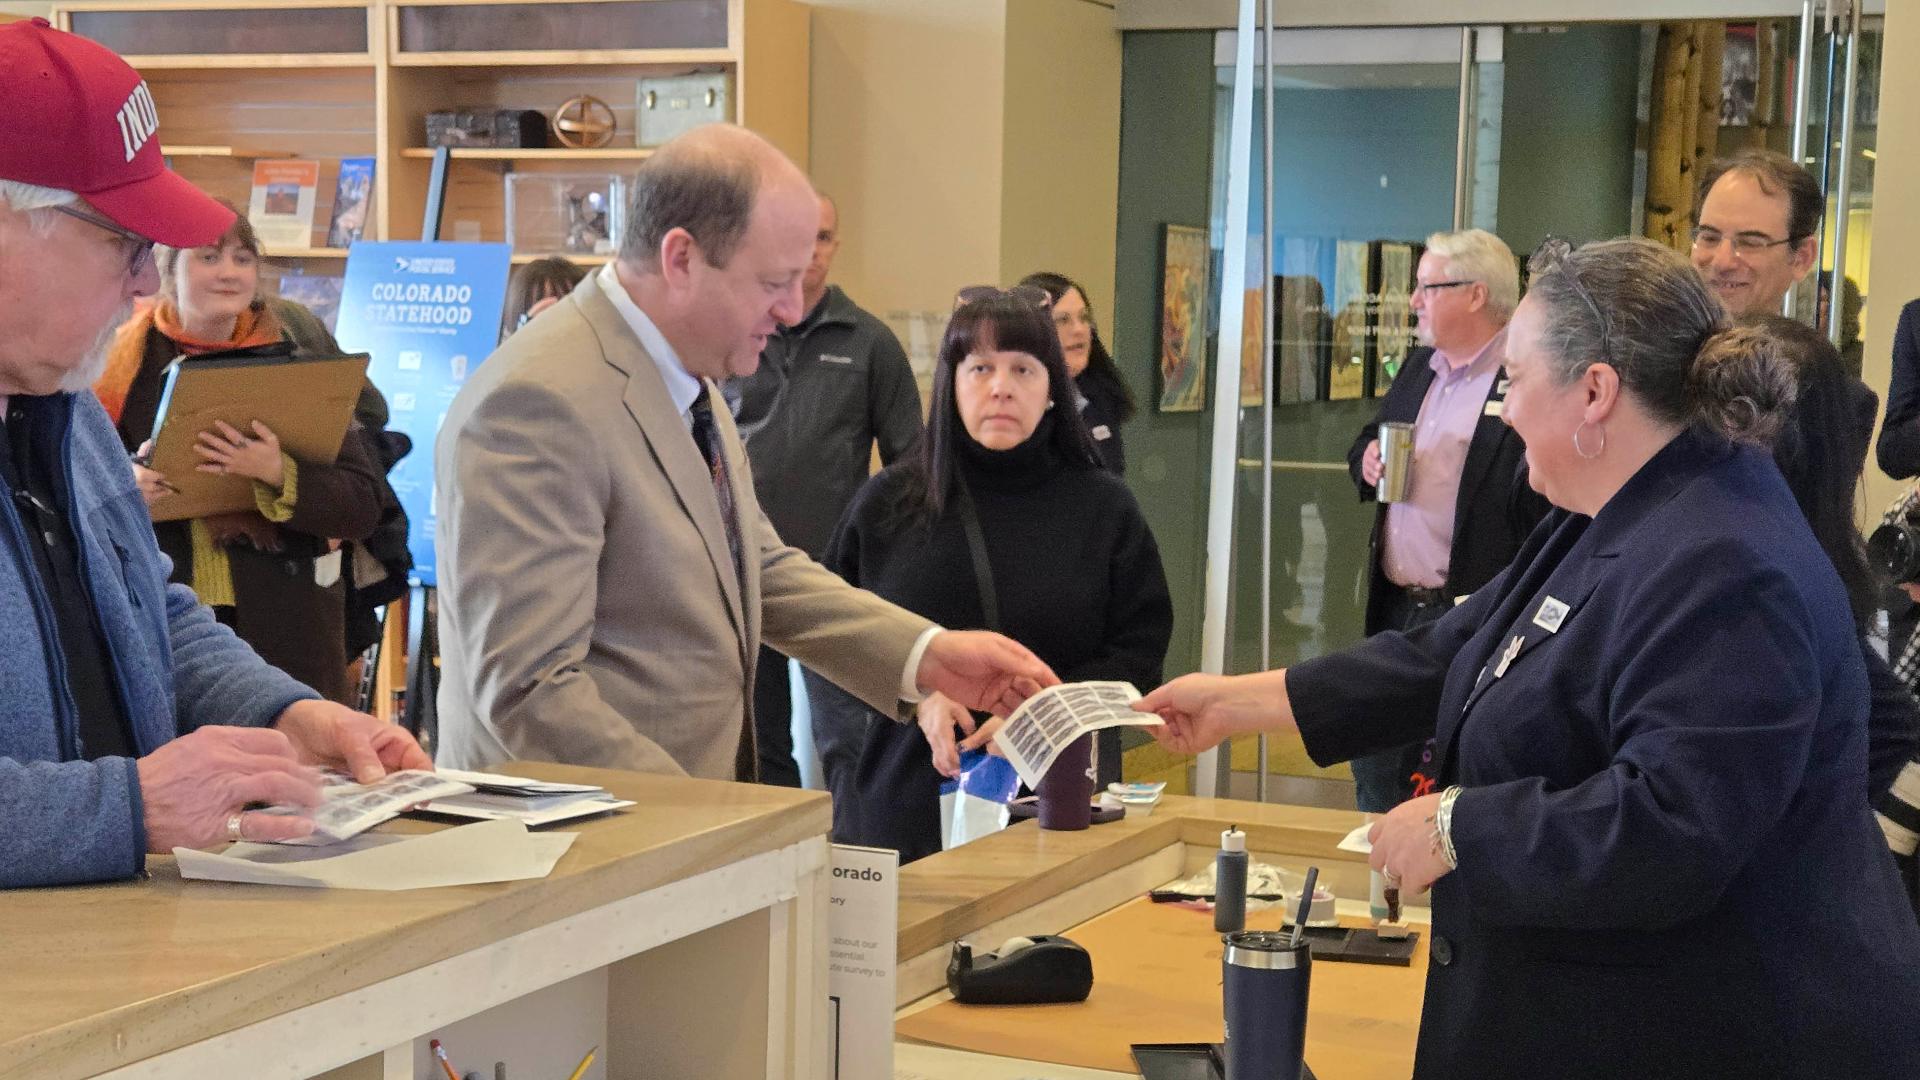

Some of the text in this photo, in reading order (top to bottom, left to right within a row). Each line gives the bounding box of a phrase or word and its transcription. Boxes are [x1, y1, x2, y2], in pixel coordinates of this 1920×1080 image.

[372, 282, 472, 304] COLORADO
[365, 303, 472, 326] STATEHOOD
[832, 867, 883, 882] orado
[832, 937, 879, 949] about our
[844, 966, 873, 977] survey
[875, 968, 886, 977] to
